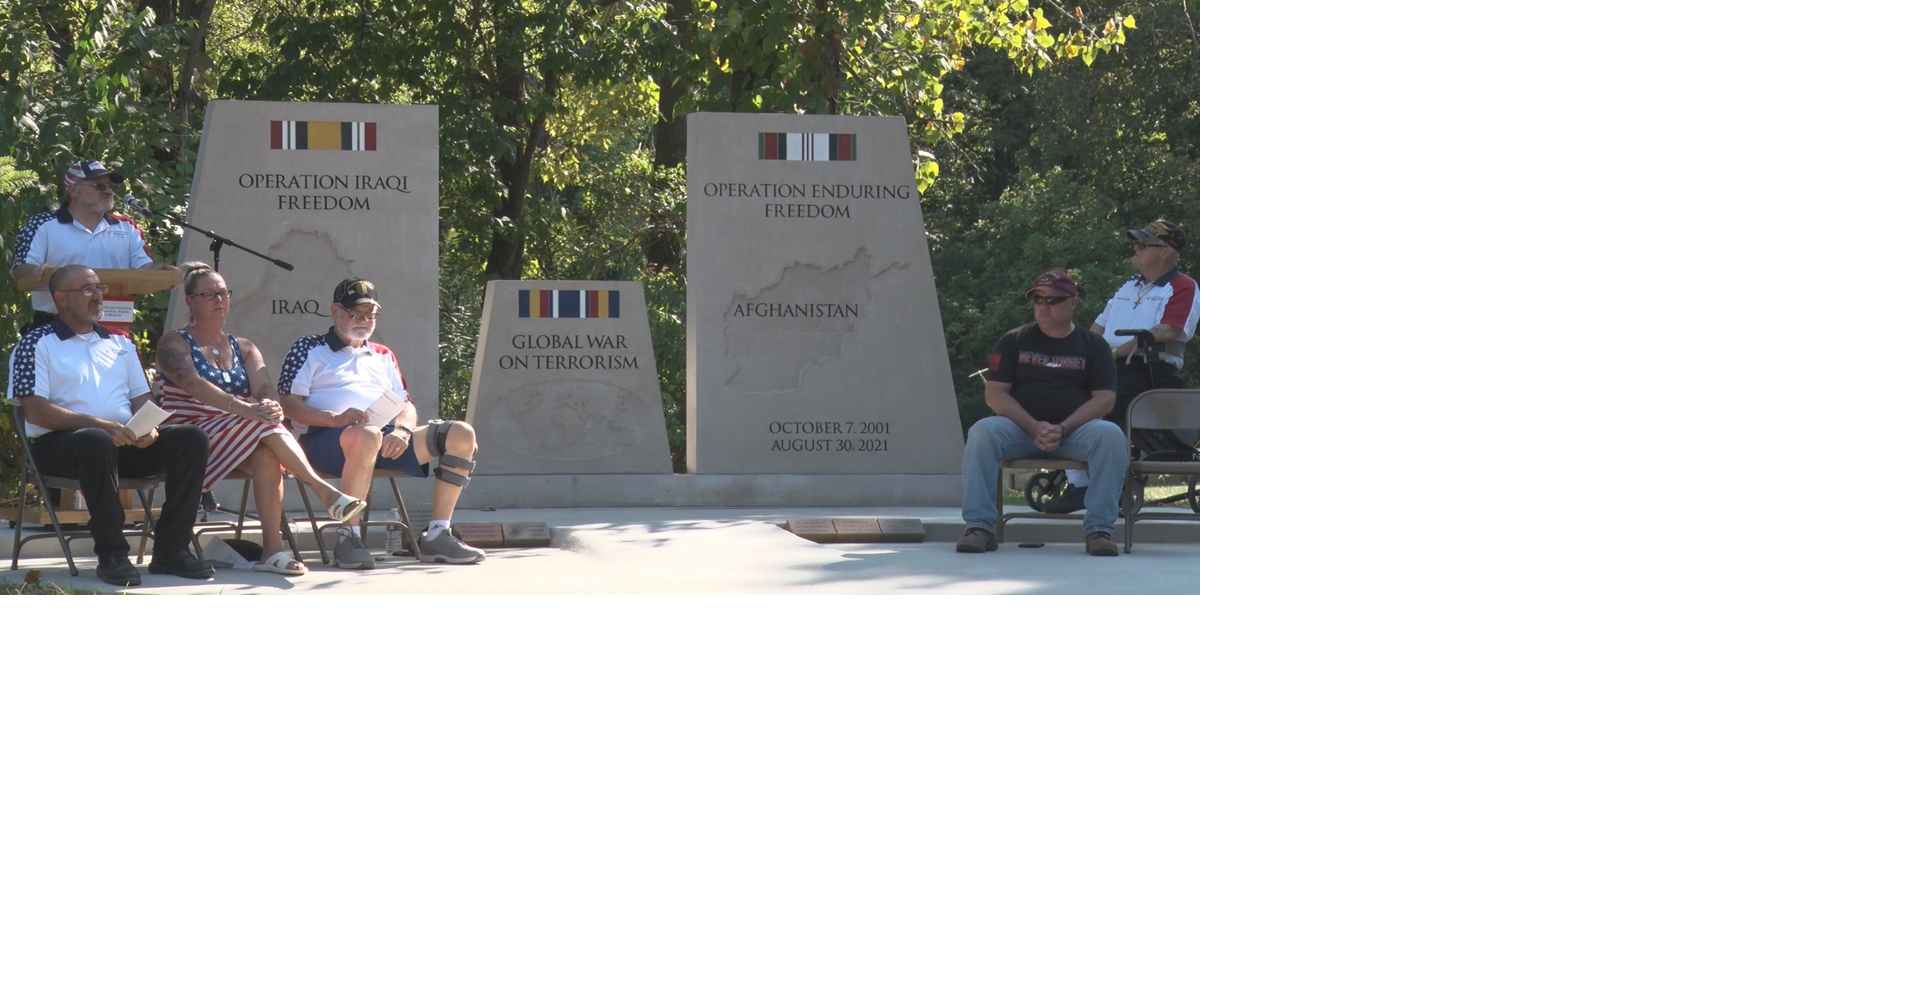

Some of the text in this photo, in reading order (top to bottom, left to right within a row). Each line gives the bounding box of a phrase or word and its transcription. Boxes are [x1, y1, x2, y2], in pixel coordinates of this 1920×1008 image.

[238, 173, 412, 194] OPERATION IRAQI
[703, 183, 910, 199] OPERATION ENDURING
[277, 194, 371, 211] FREEDOM
[764, 203, 851, 219] FREEDOM
[270, 299, 331, 318] IRAQ
[732, 302, 858, 318] AFGHANISTAN
[511, 334, 628, 349] GLOBAL WAR
[498, 354, 640, 370] ON TERRORISM
[768, 421, 890, 434] OCTOBER 7, 2001
[771, 438, 833, 452] AUGUST
[858, 438, 889, 452] 2021
